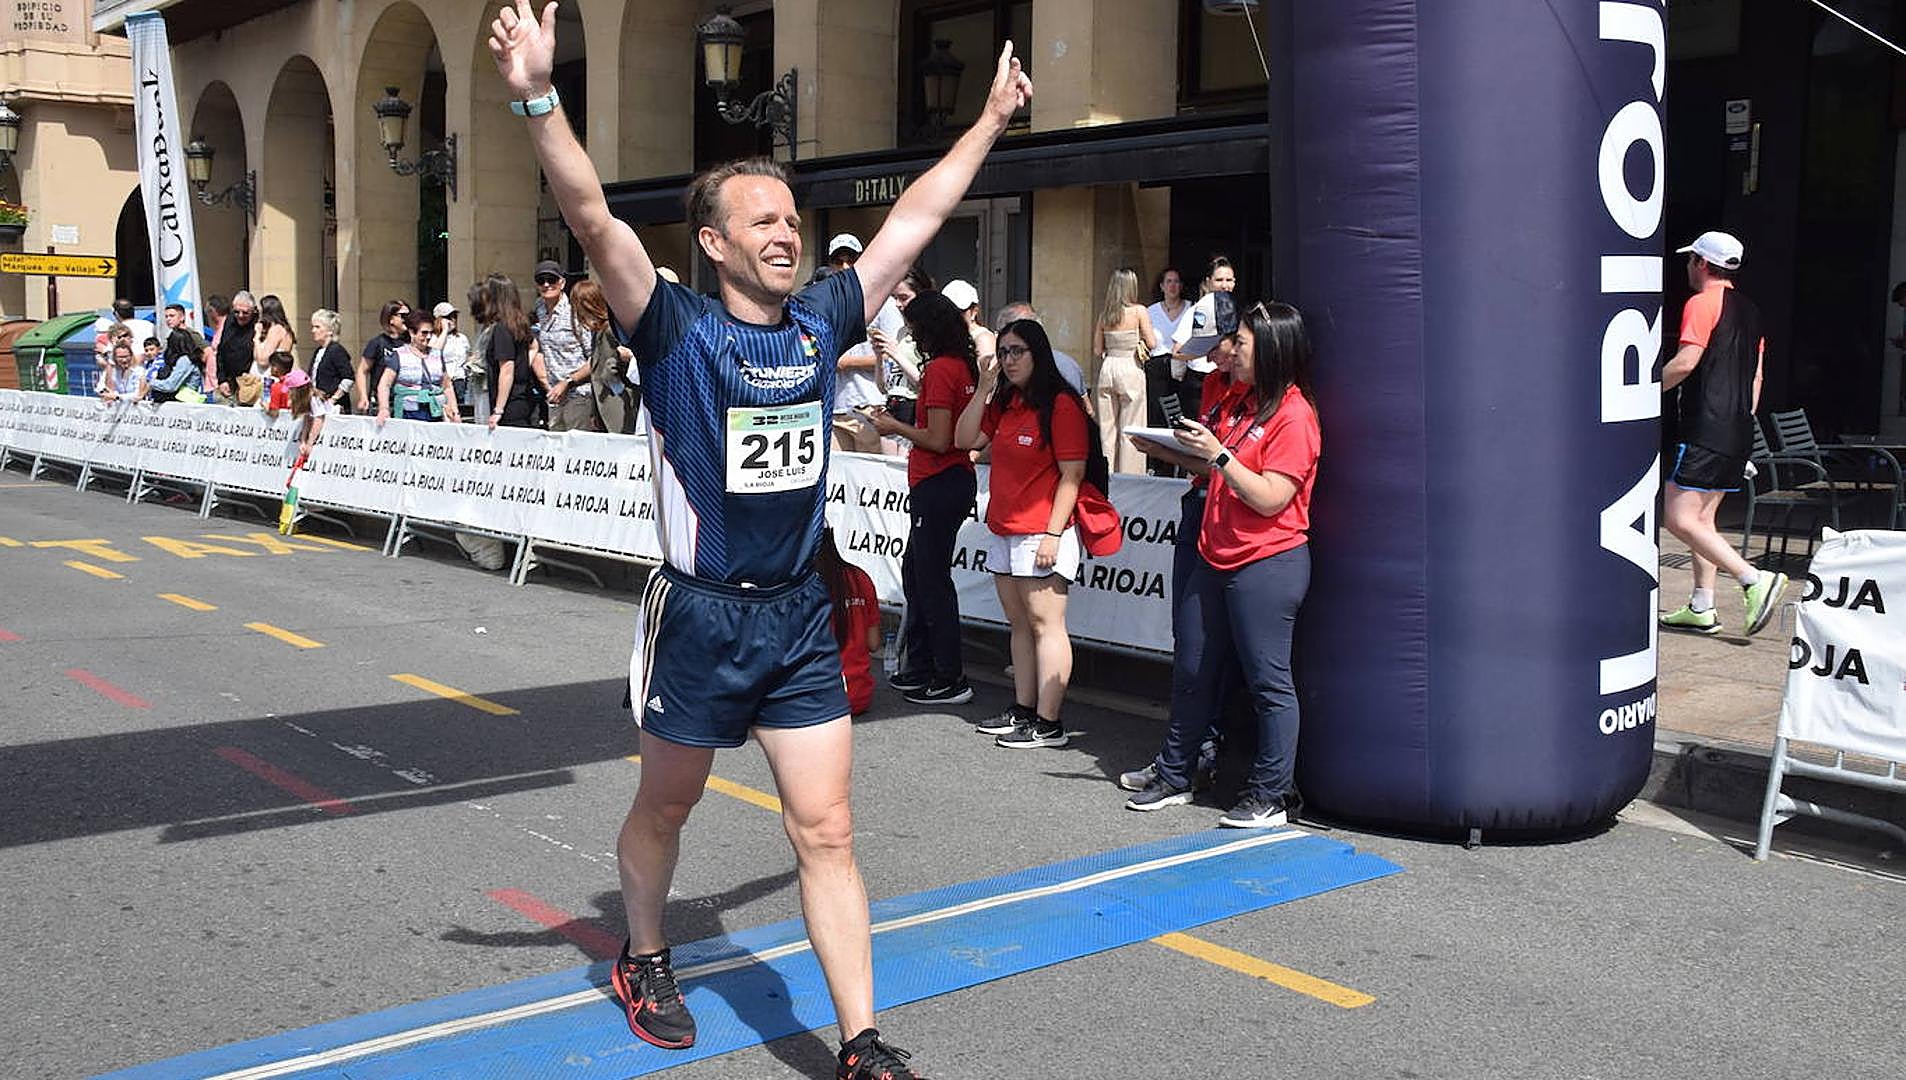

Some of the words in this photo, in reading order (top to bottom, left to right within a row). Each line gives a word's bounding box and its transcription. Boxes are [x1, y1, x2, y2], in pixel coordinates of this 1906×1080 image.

[1598, 0, 1666, 423] RIOJ
[330, 434, 339, 447] LA
[369, 439, 381, 452] LA
[740, 428, 815, 469] 215
[410, 443, 424, 457] LA
[426, 445, 453, 460] RIOJA
[459, 448, 473, 462] LA
[474, 449, 503, 464] RIOJA
[510, 452, 523, 469] LA
[525, 453, 555, 472] RIOJA
[322, 461, 332, 474] LA
[334, 463, 356, 478] RIOJA
[362, 467, 373, 480] LA
[374, 468, 398, 484] RIOJA
[565, 458, 581, 475] LA
[582, 459, 618, 479] RIOJA
[629, 463, 645, 481] LA
[758, 468, 784, 479] JOSE
[786, 466, 806, 477] LUIS
[402, 472, 416, 486] LA
[418, 475, 445, 491] RIOJA
[452, 479, 464, 493] LA
[466, 480, 494, 498] RIOJA
[501, 485, 514, 501] LA
[516, 487, 545, 506] RIOJA
[556, 492, 571, 511] LA
[573, 493, 609, 515] RIOJA
[859, 487, 880, 508] LA
[883, 490, 911, 513] RIO
[619, 499, 636, 518] LA
[1121, 516, 1177, 545] IOJA
[849, 530, 870, 553] LA
[873, 534, 903, 558] RIO
[951, 546, 968, 569] A
[1074, 563, 1085, 587] A
[1090, 564, 1165, 599] RIOJA
[1599, 450, 1661, 696] LA
[1801, 572, 1885, 614] OJA
[1789, 636, 1869, 685] OJA
[1599, 692, 1657, 735] DIARIO
